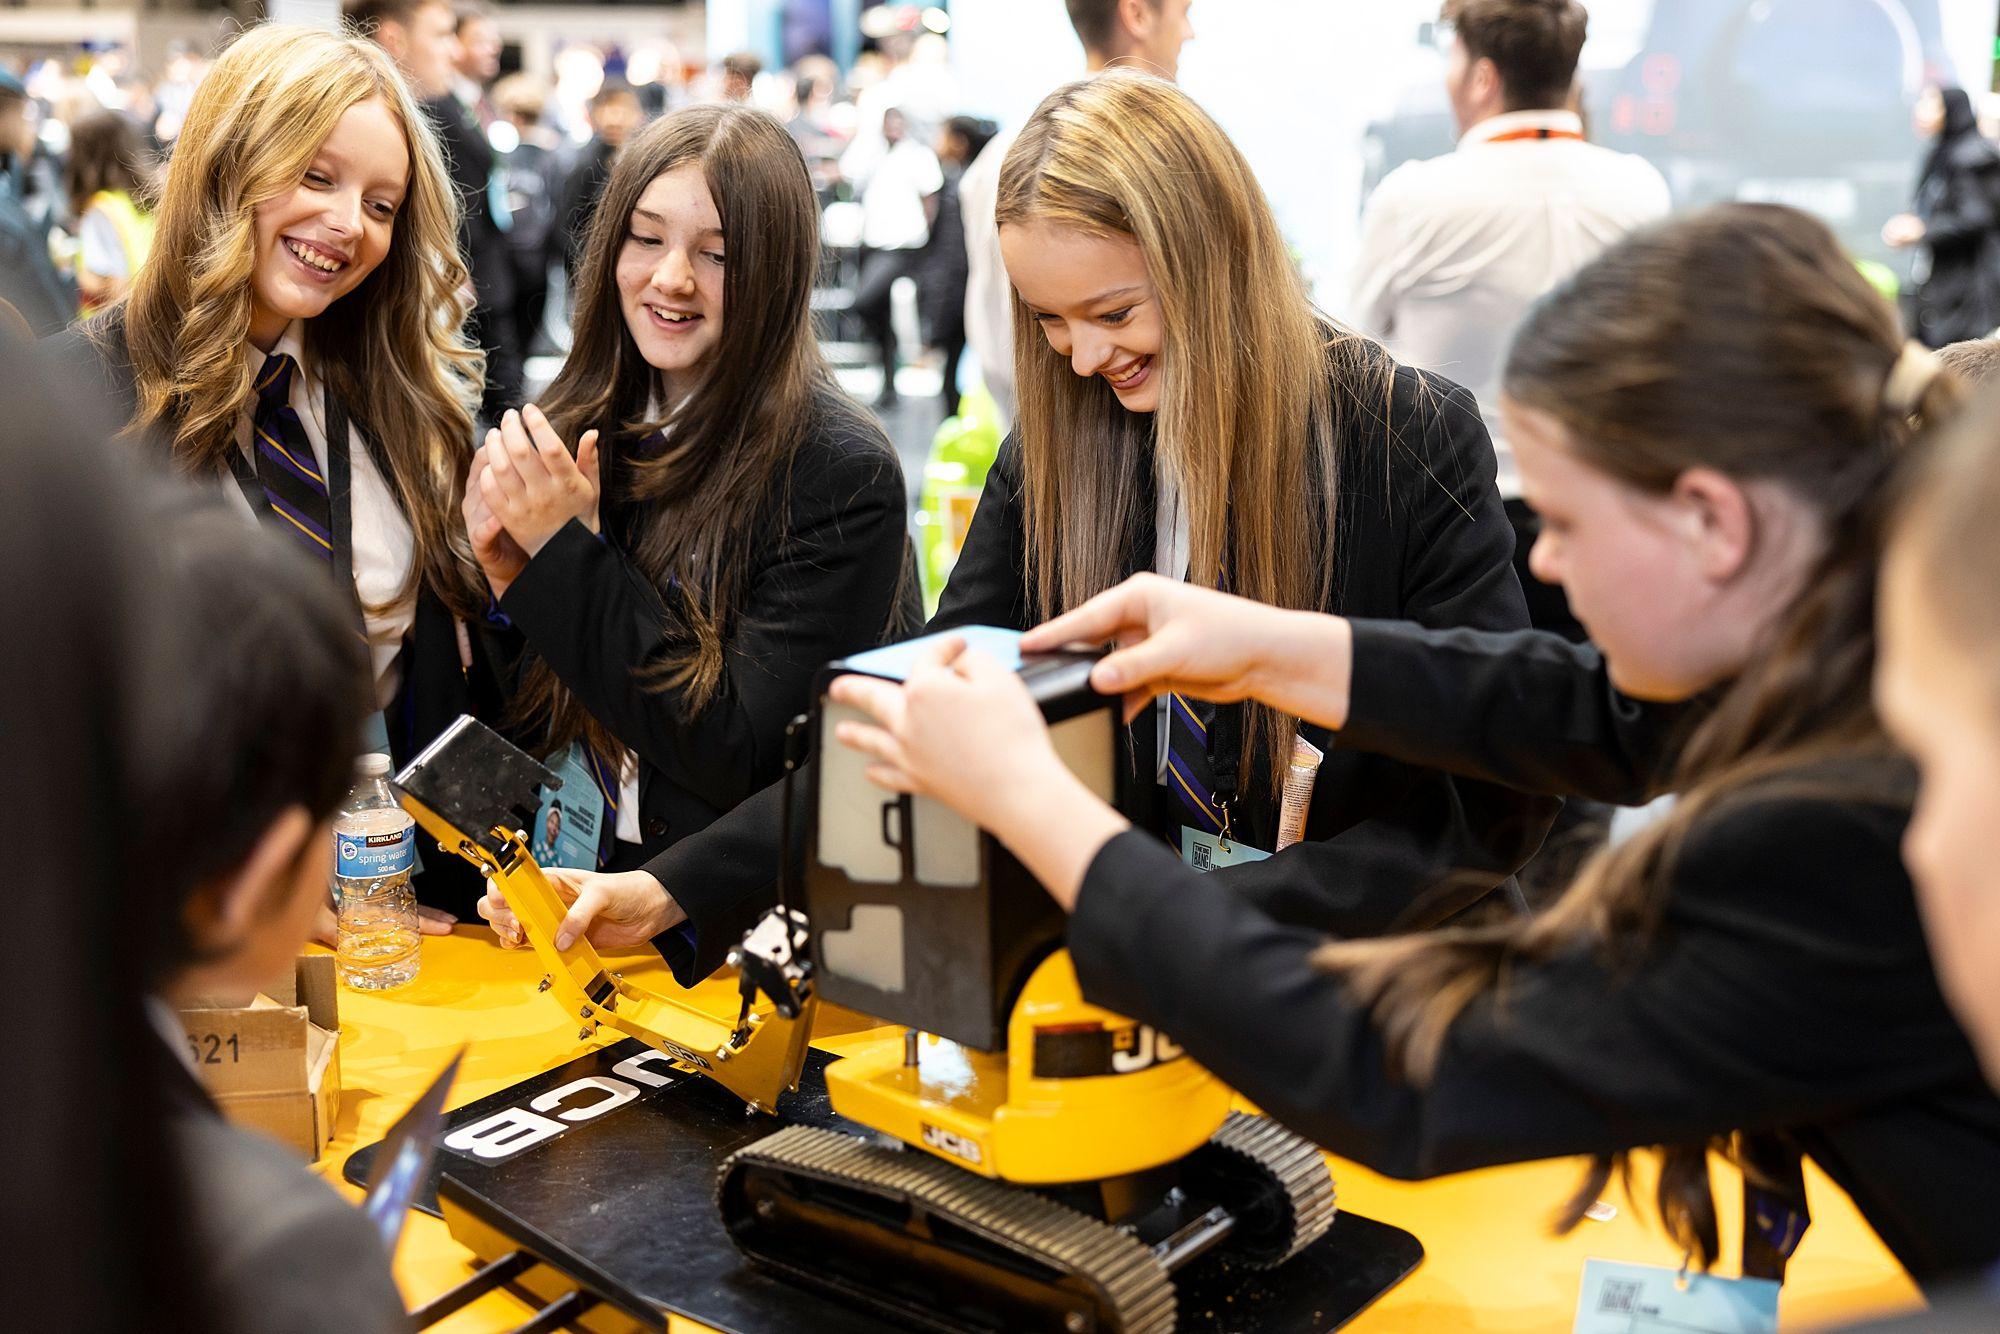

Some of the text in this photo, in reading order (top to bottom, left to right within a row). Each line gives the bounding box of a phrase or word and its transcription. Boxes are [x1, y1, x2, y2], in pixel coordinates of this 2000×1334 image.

[368, 832, 402, 843] KIRKLAND
[358, 853, 387, 865] spring
[664, 1040, 709, 1067] JCB
[922, 1126, 981, 1163] JCB
